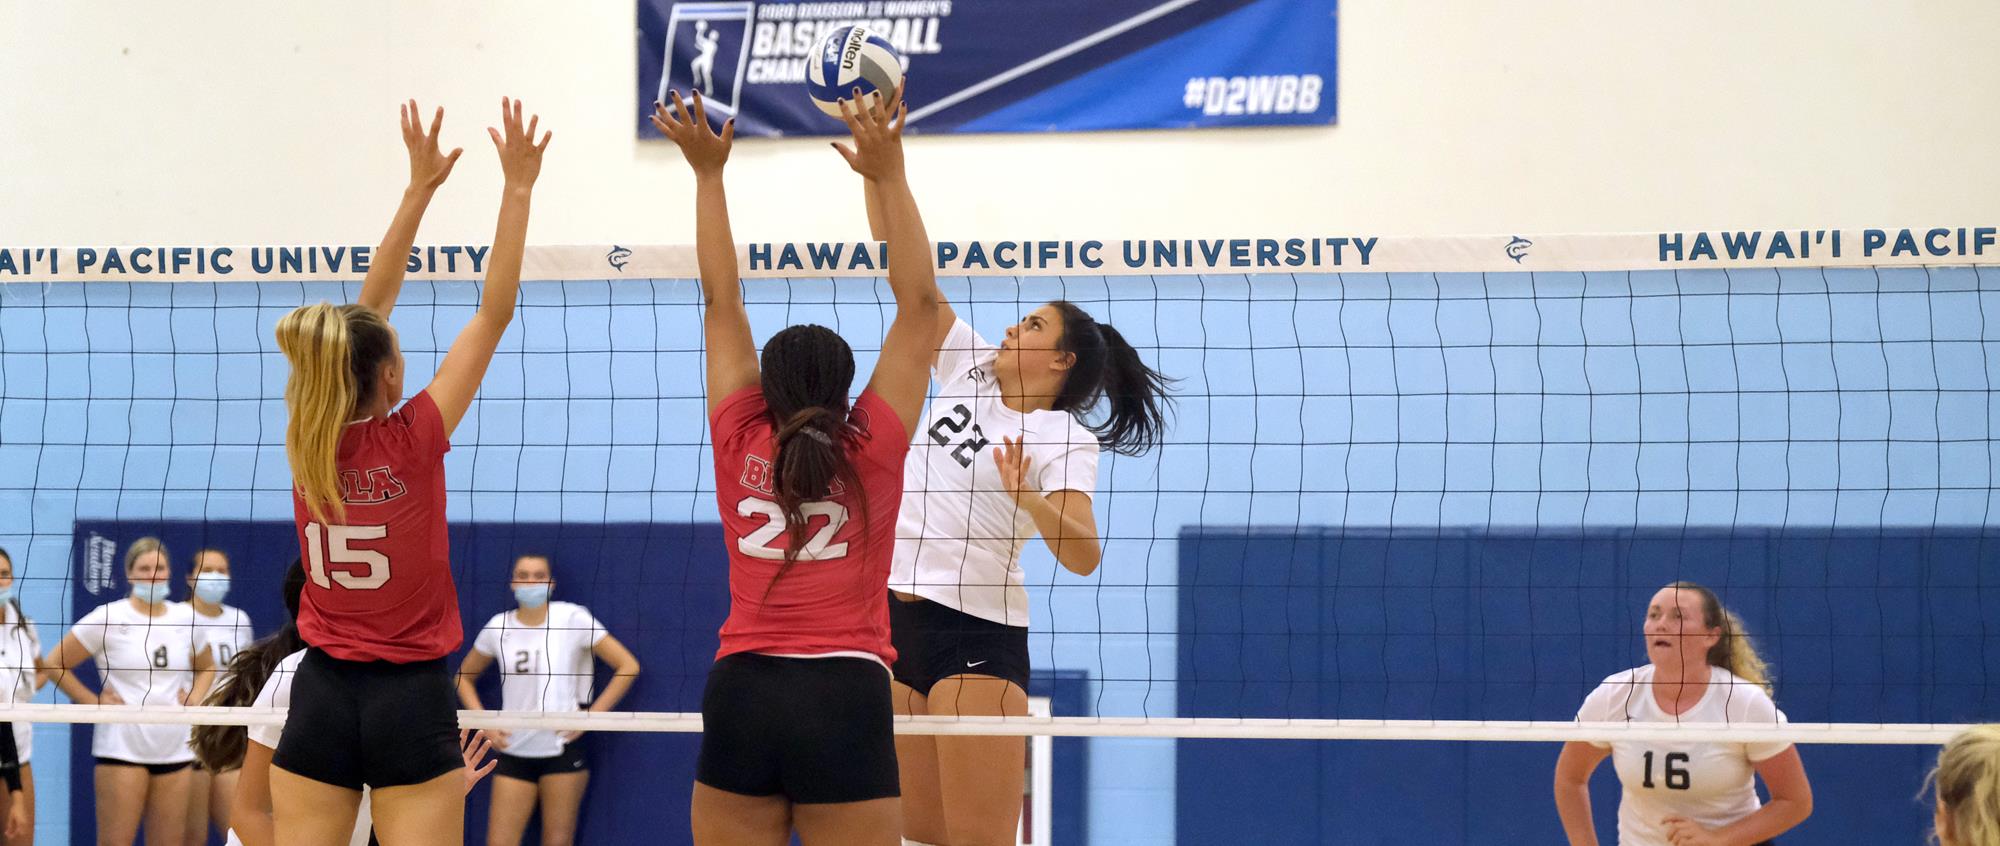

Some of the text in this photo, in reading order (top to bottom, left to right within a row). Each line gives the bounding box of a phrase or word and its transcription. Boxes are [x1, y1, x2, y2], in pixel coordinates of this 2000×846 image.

[798, 2, 866, 18] DIVISION
[885, 1, 952, 16] WOMEN'S
[752, 18, 942, 58] BASBALL
[842, 26, 866, 70] molten
[1184, 74, 1324, 116] #D2WBB
[76, 247, 233, 275] PACIFIC
[251, 245, 489, 274] UNIVESITY
[749, 237, 1379, 270] HAWAI PACIFIC UNIVERSITY
[1658, 227, 1997, 262] HAWAI'I PACIF
[928, 404, 990, 469] 22
[737, 496, 850, 561] 22
[304, 521, 391, 590] 15
[153, 645, 168, 668] 8
[515, 649, 541, 673] 21
[1641, 750, 1691, 790] 16
